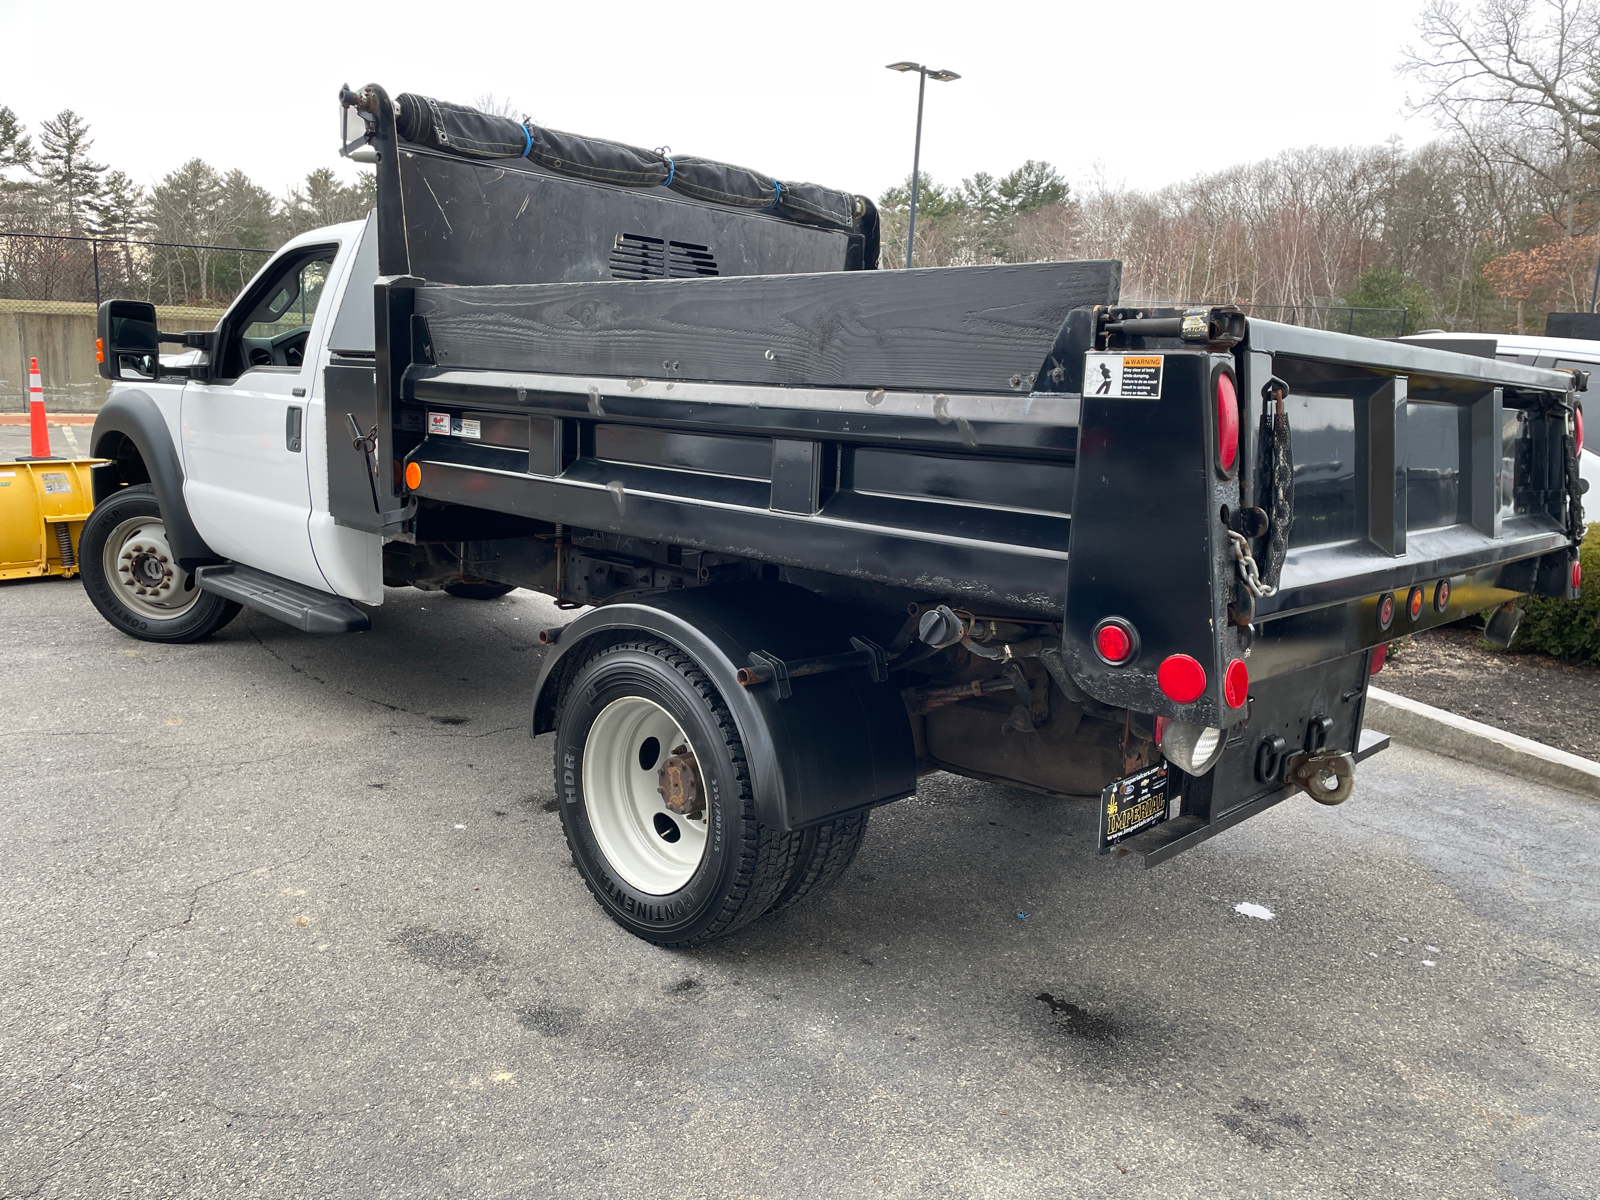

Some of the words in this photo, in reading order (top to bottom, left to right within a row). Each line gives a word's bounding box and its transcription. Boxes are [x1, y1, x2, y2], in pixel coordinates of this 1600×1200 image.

[99, 509, 122, 528] HSR
[563, 752, 577, 804] HDR
[1106, 810, 1165, 841] www.imperialcars.com
[1107, 792, 1165, 835] IMPERIAL
[593, 859, 696, 922] CONTINENTAL
